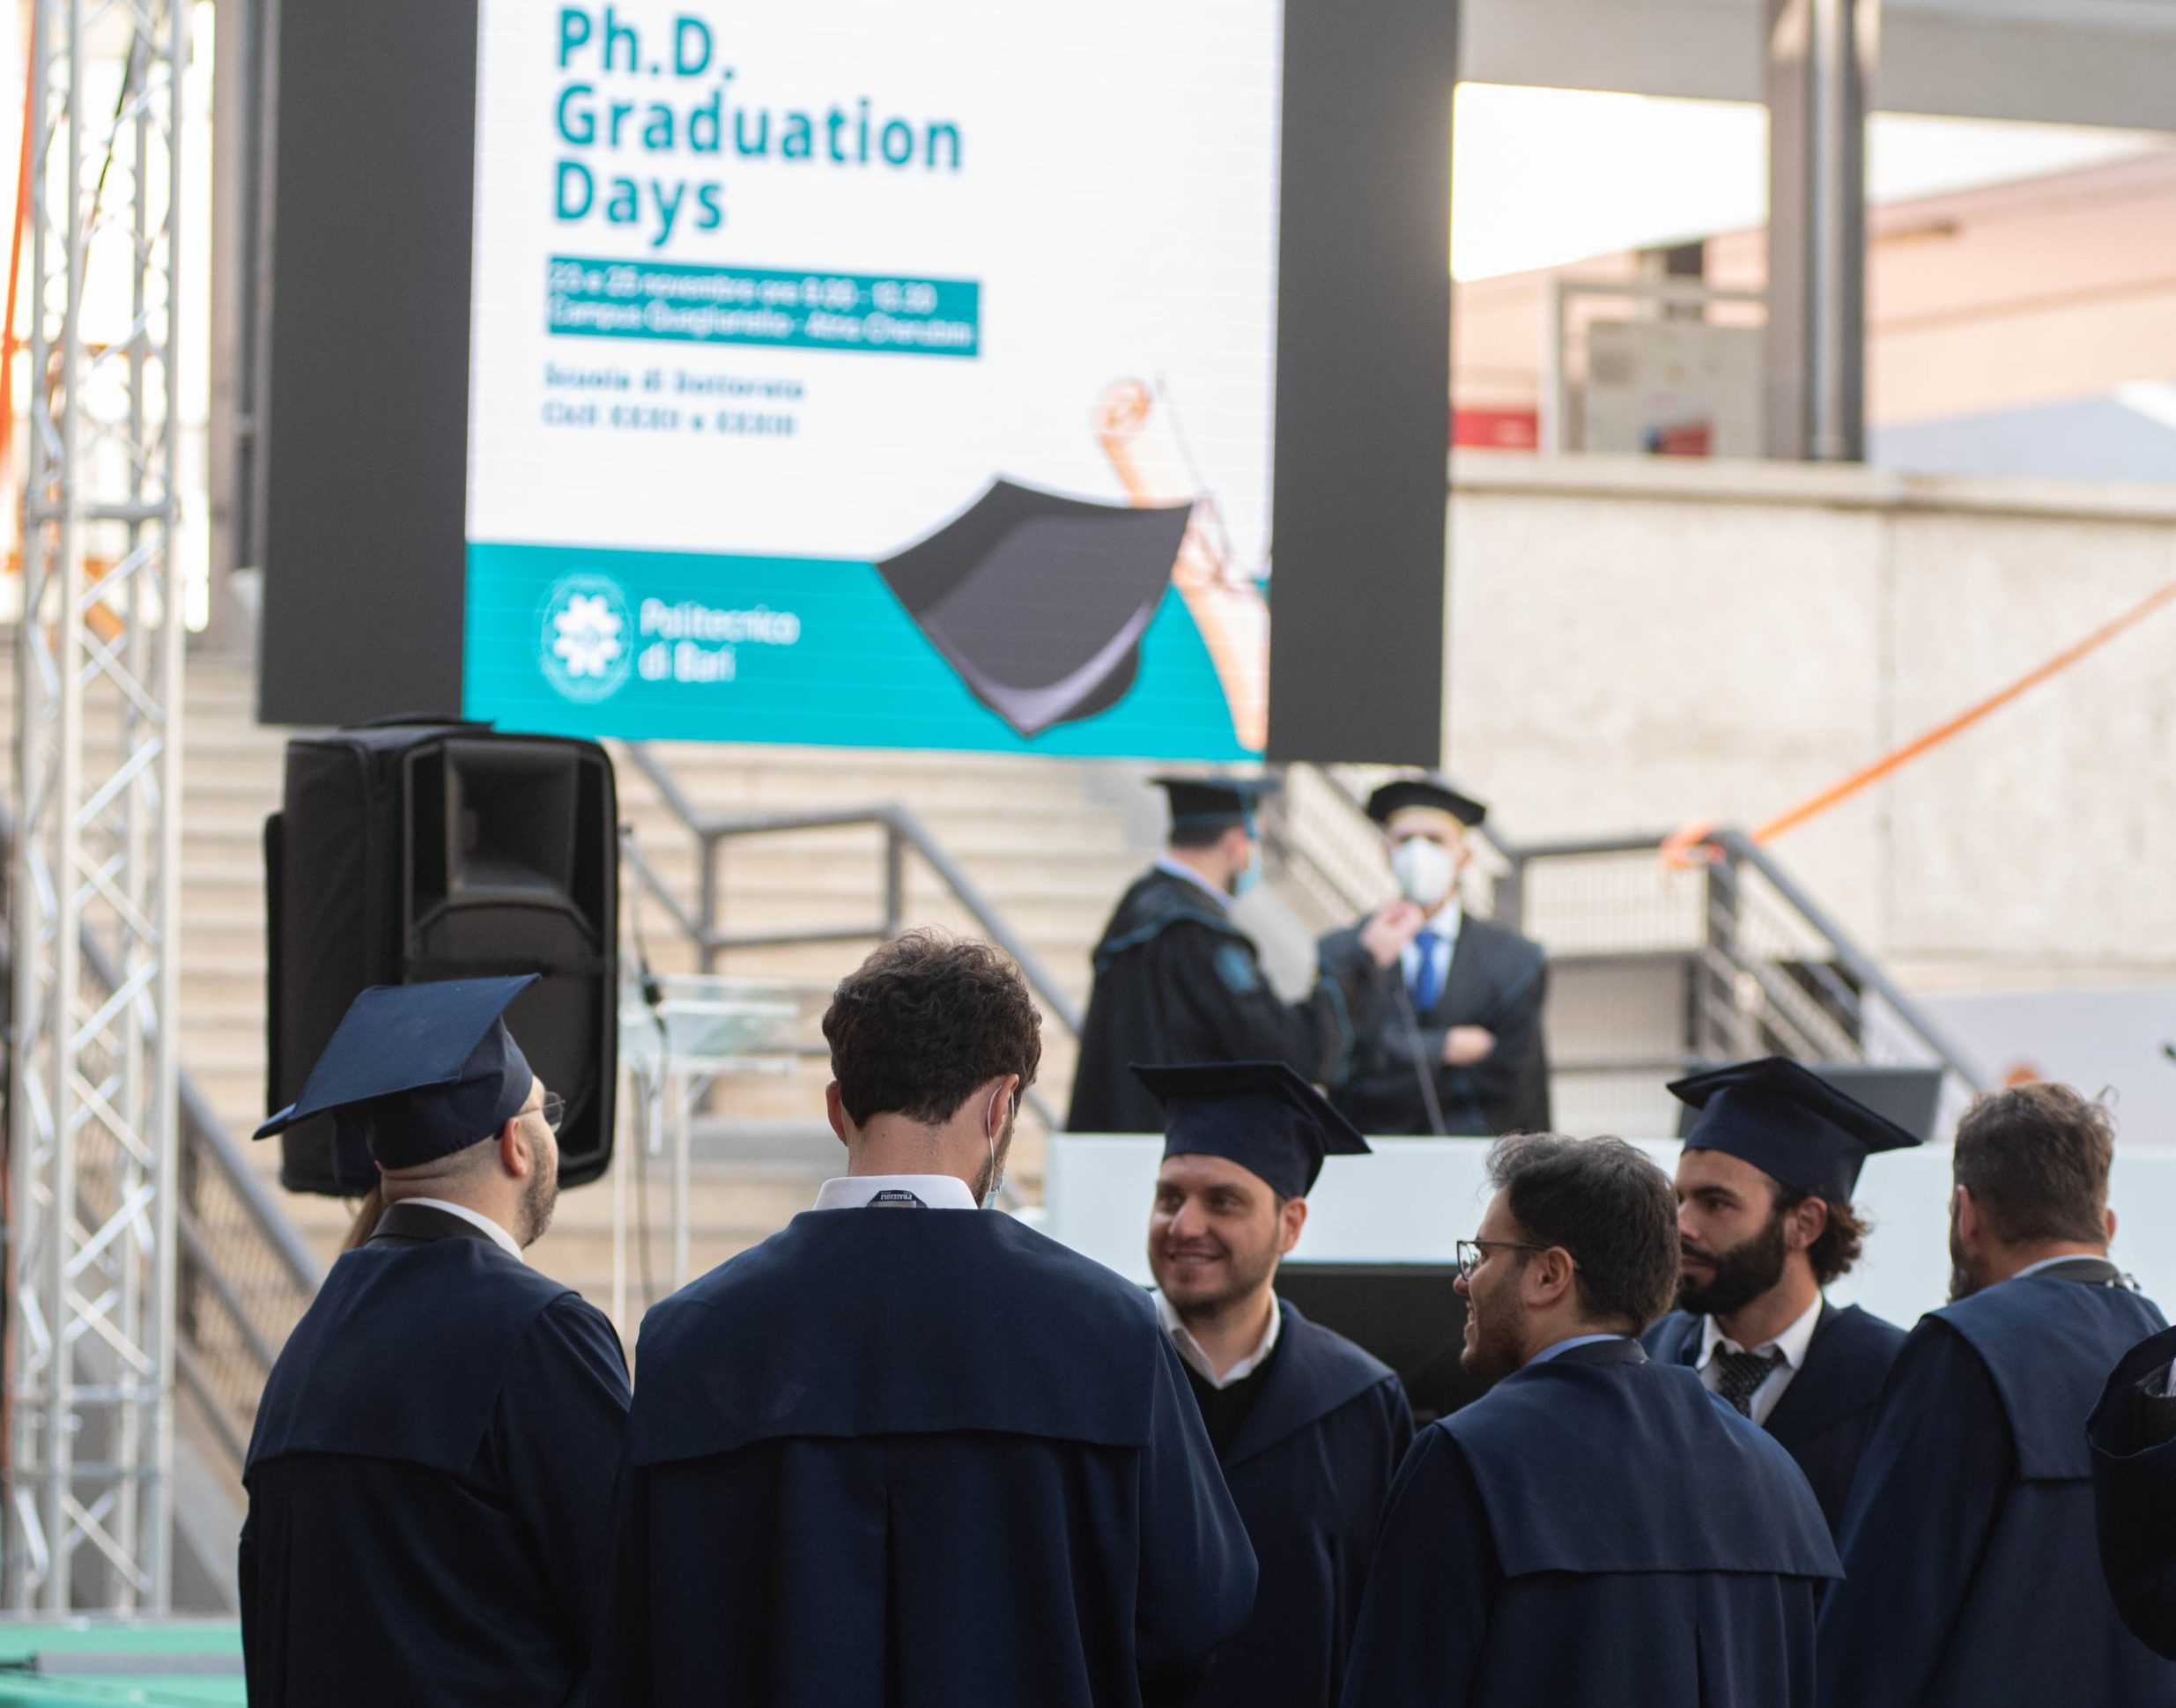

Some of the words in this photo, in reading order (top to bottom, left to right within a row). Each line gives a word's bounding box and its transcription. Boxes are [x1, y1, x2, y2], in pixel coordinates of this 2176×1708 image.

[558, 6, 735, 80] Ph.D.
[556, 83, 961, 169] Graduation
[554, 159, 723, 248] Days
[640, 596, 801, 645] Politecnico
